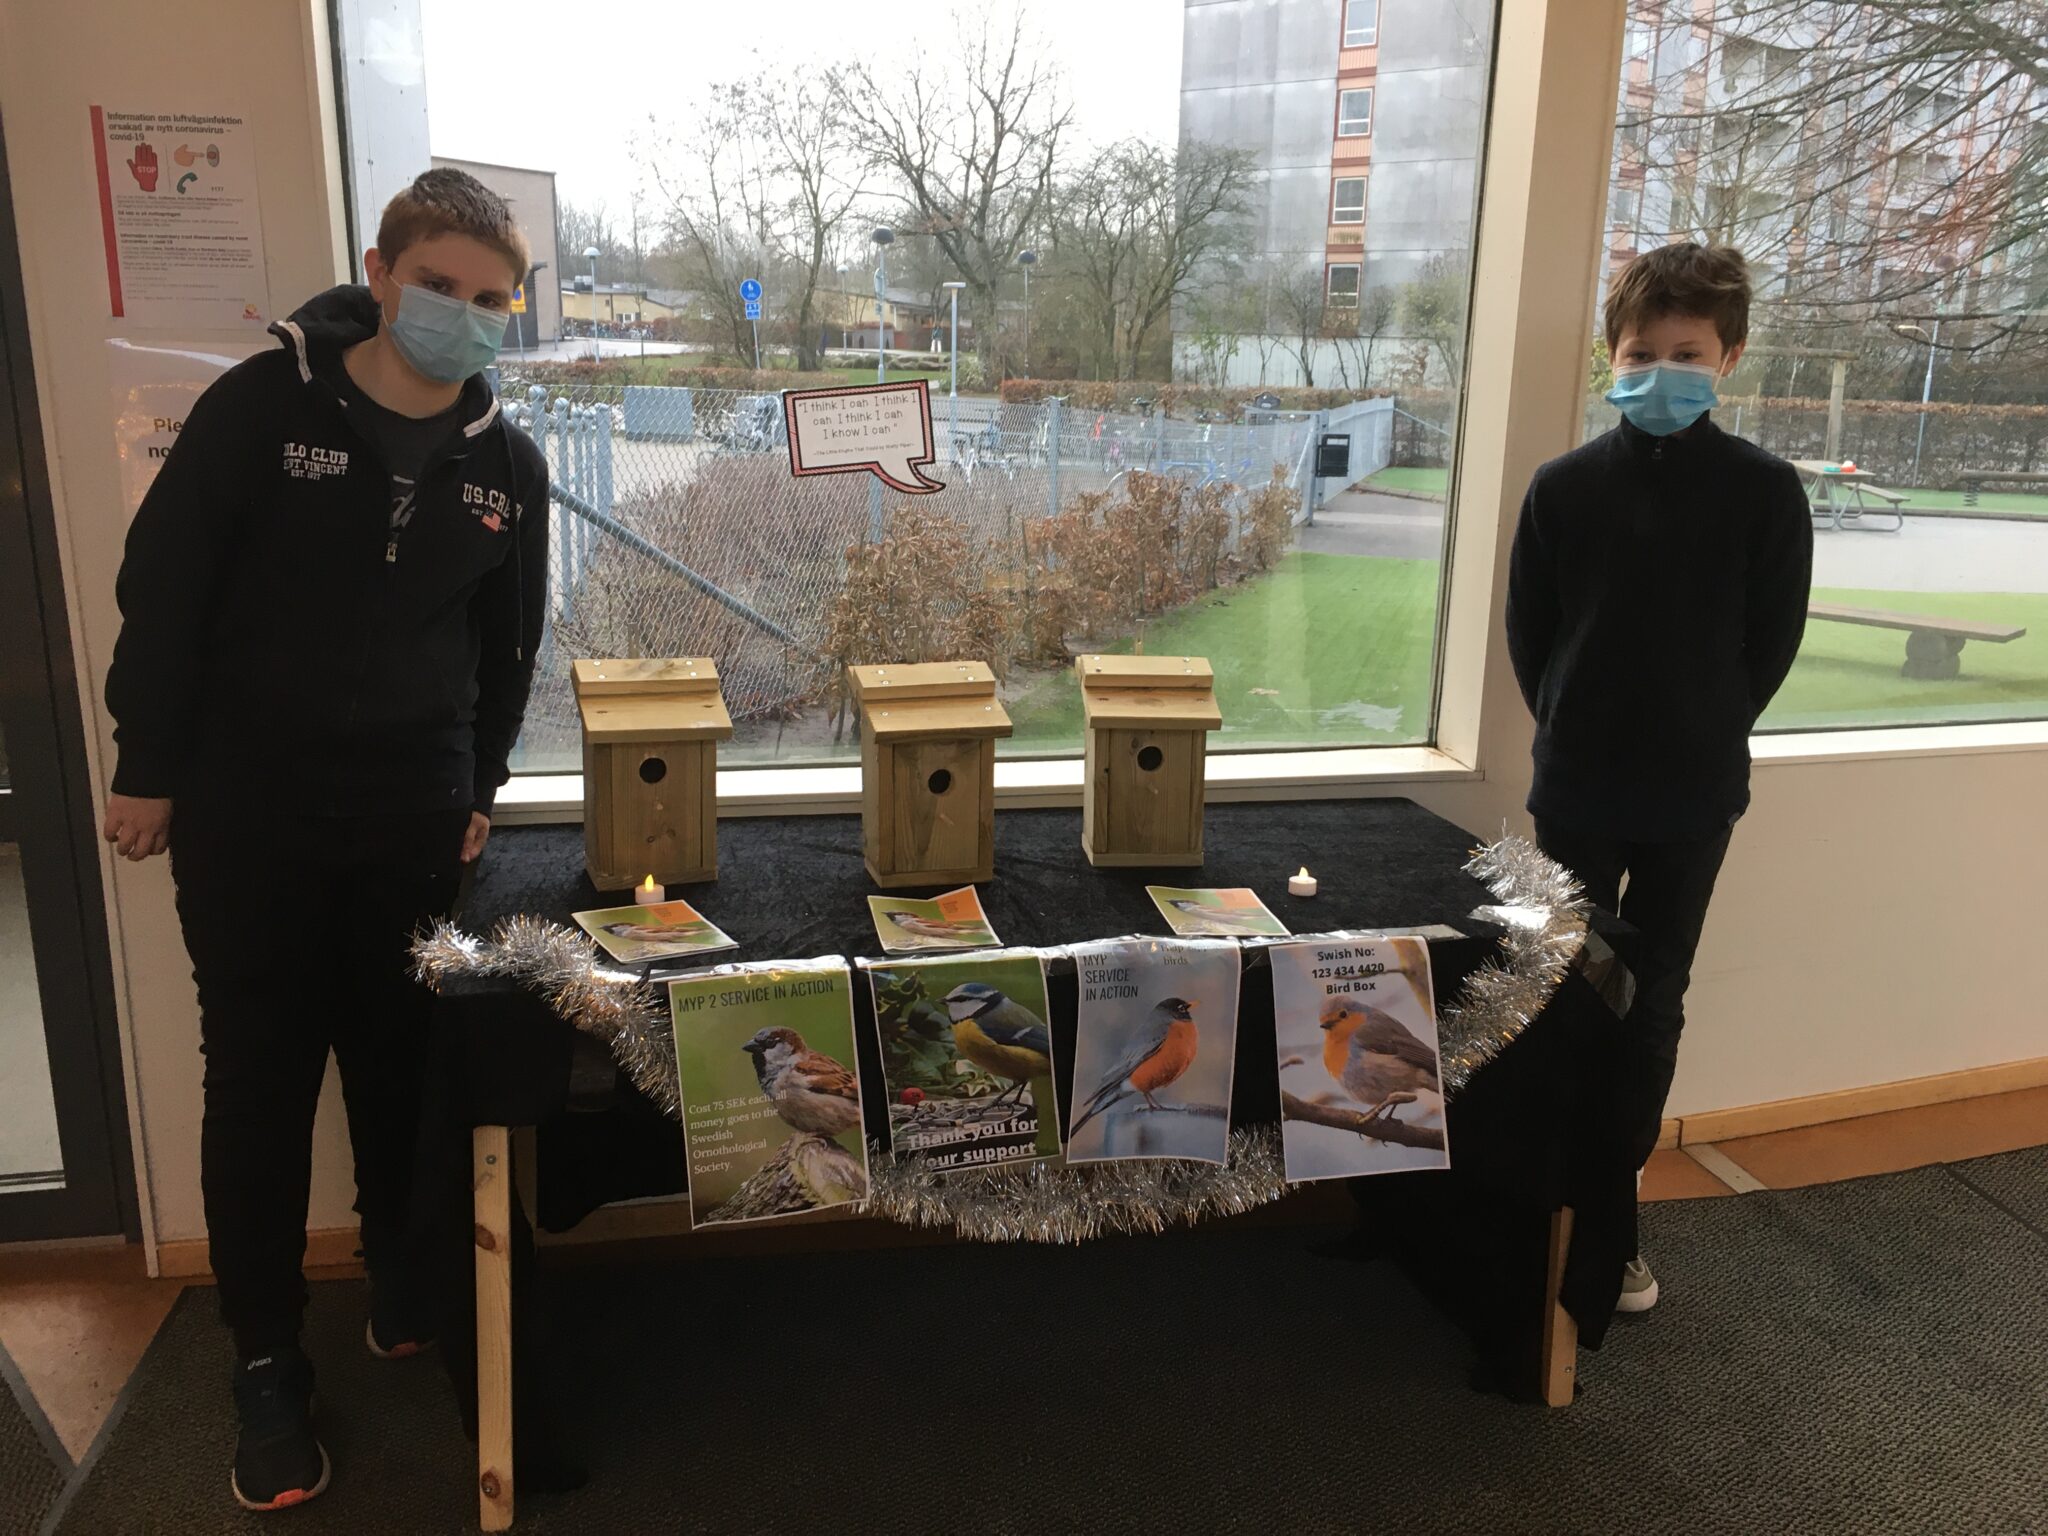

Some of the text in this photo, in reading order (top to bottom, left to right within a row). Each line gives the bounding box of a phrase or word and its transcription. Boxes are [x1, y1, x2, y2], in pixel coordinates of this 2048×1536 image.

[107, 112, 243, 125] Information om luftvägsinfektion
[108, 123, 142, 131] orsakad
[157, 125, 173, 133] nytt
[175, 125, 224, 134] coronavirus
[109, 132, 145, 141] covid-19
[811, 400, 838, 412] think
[841, 399, 847, 410] I
[849, 399, 869, 408] can
[874, 396, 880, 407] I
[882, 394, 909, 406] think
[911, 392, 917, 403] I
[153, 417, 182, 432] Ple
[813, 410, 903, 426] can I think I can
[823, 428, 829, 440] I
[832, 425, 860, 438] know
[863, 425, 869, 436] I
[311, 447, 349, 465] CLUB
[304, 460, 347, 475] VINCENT
[1084, 954, 1107, 967] MYP
[1164, 956, 1188, 966] birds
[1317, 948, 1375, 961] Swish No:
[1085, 968, 1130, 984] SERVICE
[1312, 962, 1385, 979] 123 434 4420
[679, 979, 834, 1012] MYP 2 SERVICE IN ACTION
[1085, 985, 1138, 1001] IN ACTION
[1326, 982, 1376, 995] Bird Box
[689, 1089, 787, 1114] Cost 75 SEK each, all
[690, 1106, 779, 1130] money goes to the
[691, 1129, 733, 1145] Swedish
[907, 1118, 1038, 1148] Thank you for
[926, 1141, 1037, 1168] our support
[694, 1161, 733, 1175] Society.
